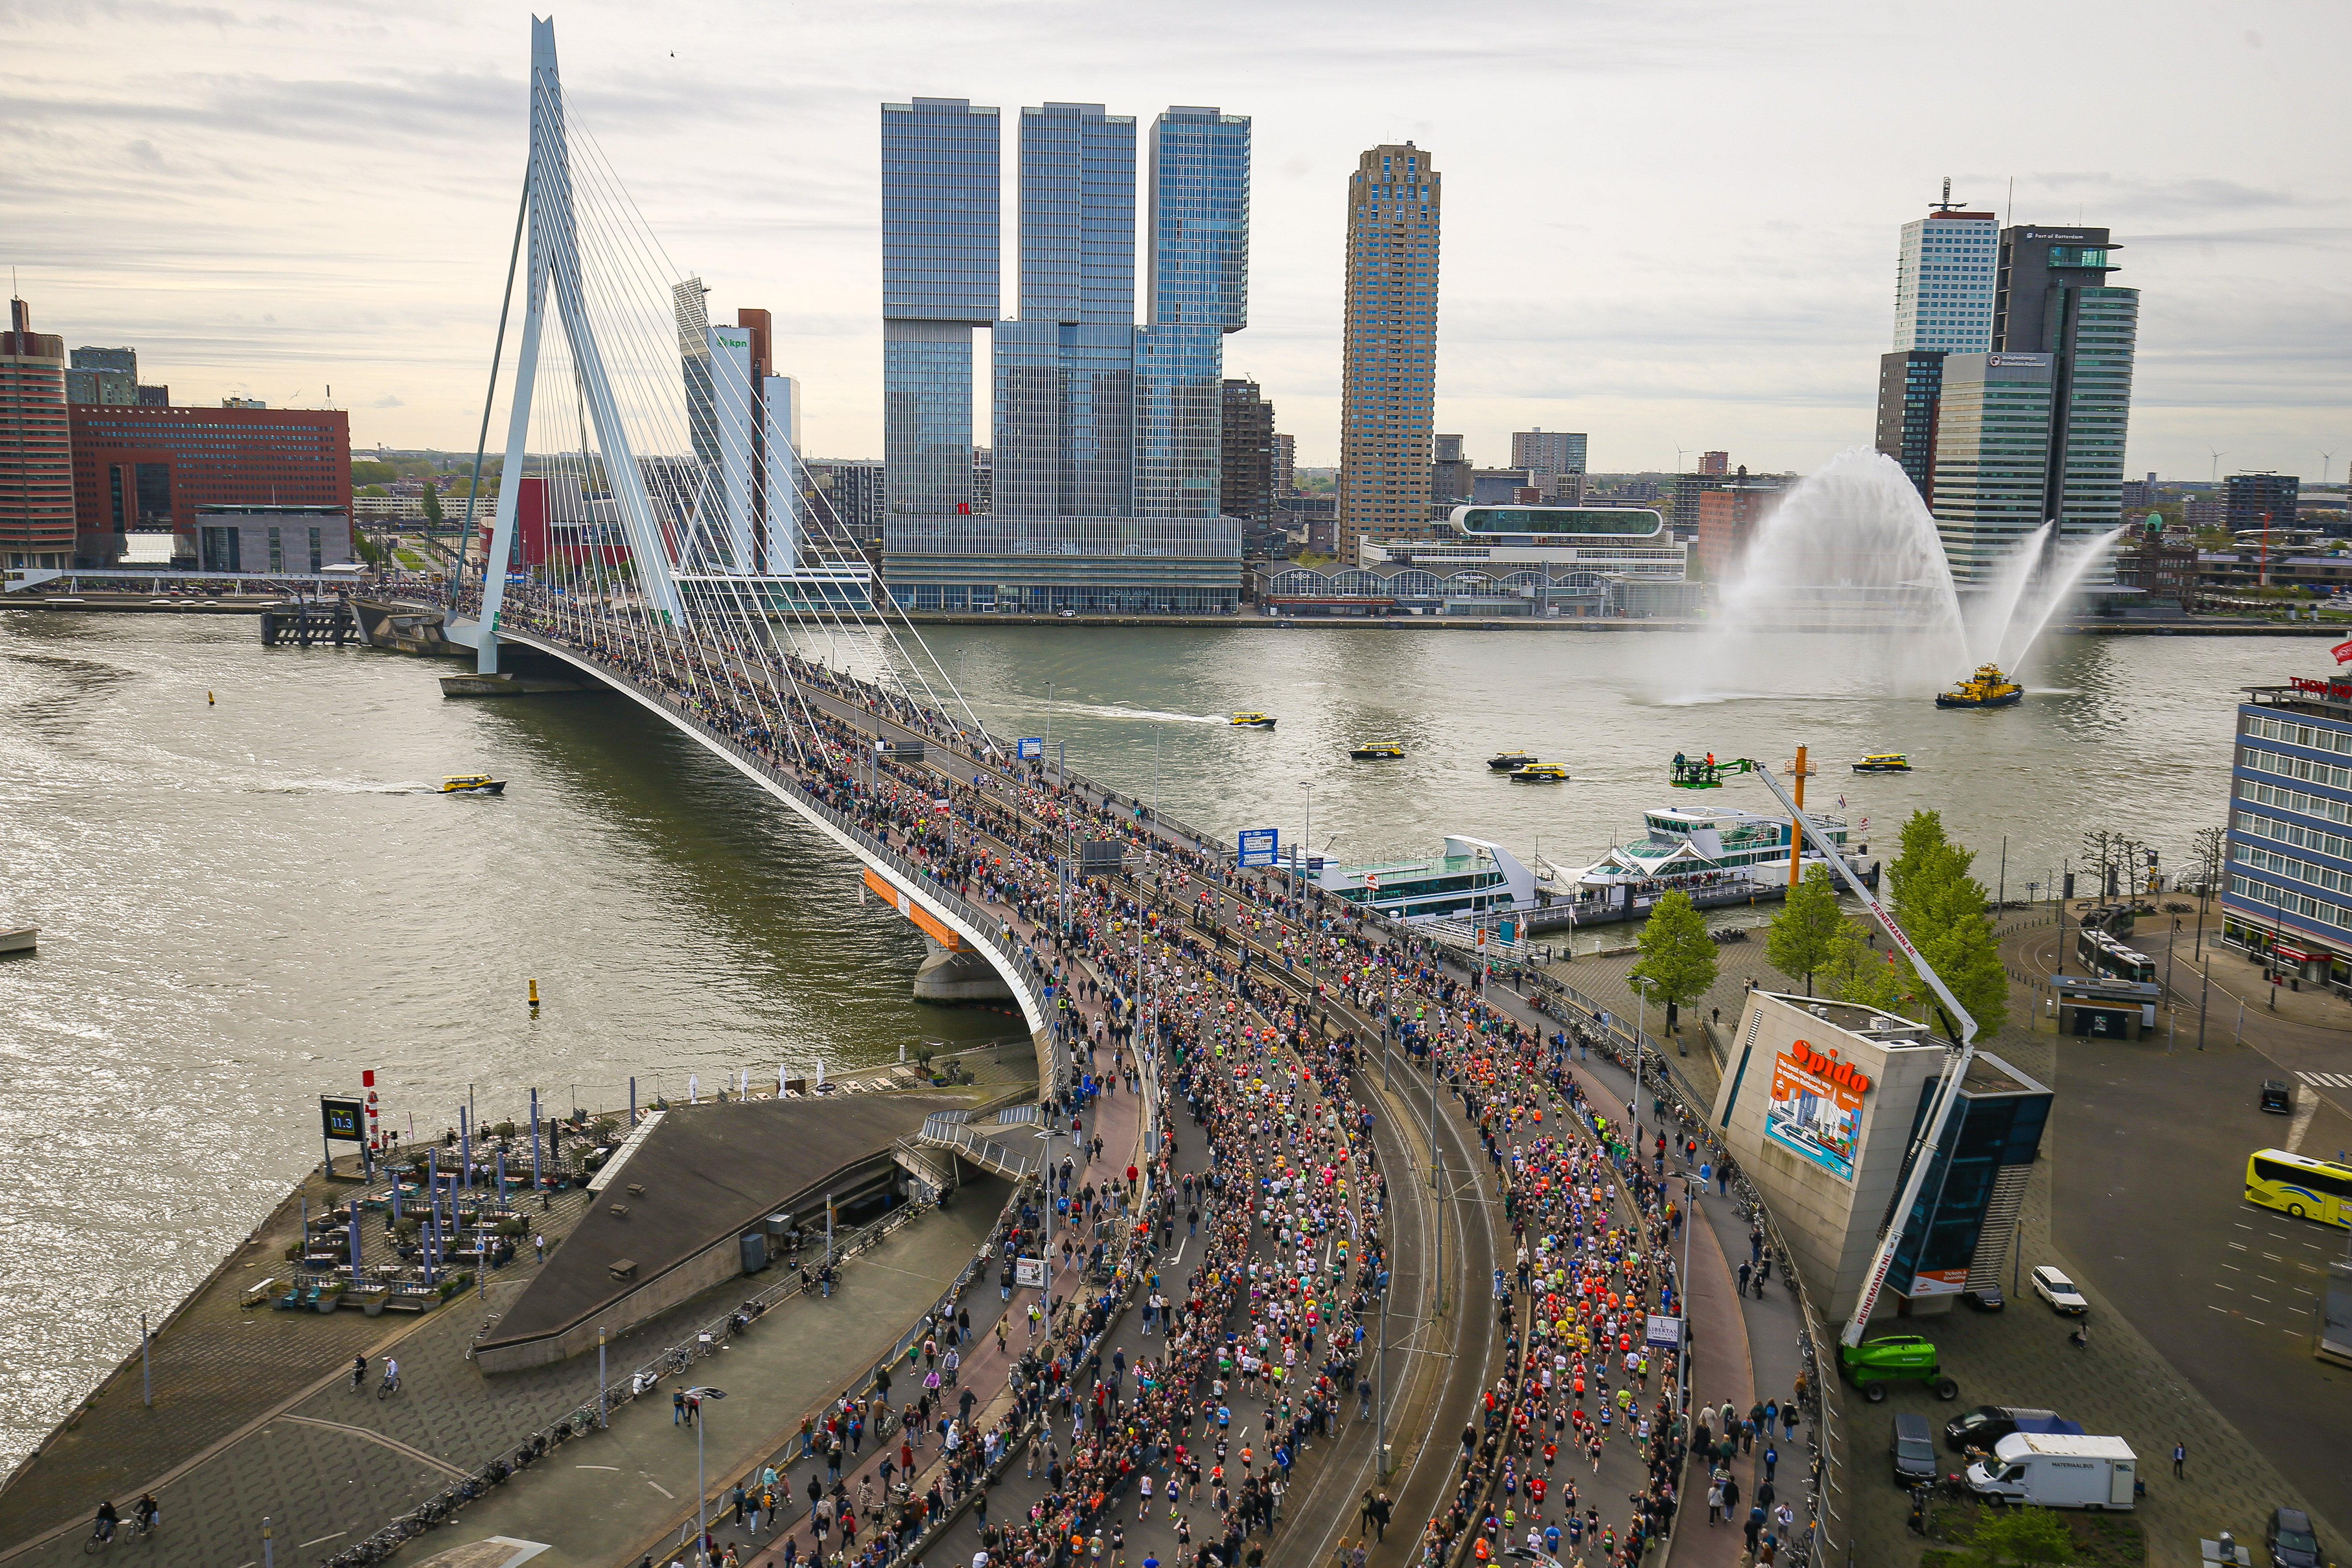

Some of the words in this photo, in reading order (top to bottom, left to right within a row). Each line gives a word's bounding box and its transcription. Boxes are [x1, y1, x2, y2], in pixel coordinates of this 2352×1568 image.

[729, 339, 747, 348] kpn
[2289, 676, 2329, 695] THON
[1870, 901, 1915, 958] PEINEMANN.NL
[1778, 1057, 1787, 1068] The
[1787, 1063, 1799, 1074] most
[1799, 1069, 1822, 1086] enjoyable
[1821, 1079, 1832, 1091] way
[1790, 1039, 1869, 1092] Spido
[1782, 1069, 1800, 1082] explore
[1799, 1077, 1825, 1096] Rotterdam
[1842, 1092, 1859, 1104] spido.nl
[332, 1117, 352, 1128] 11.3
[1857, 1253, 1892, 1325] PEINEMANN.NL
[1660, 1319, 1666, 1328] L
